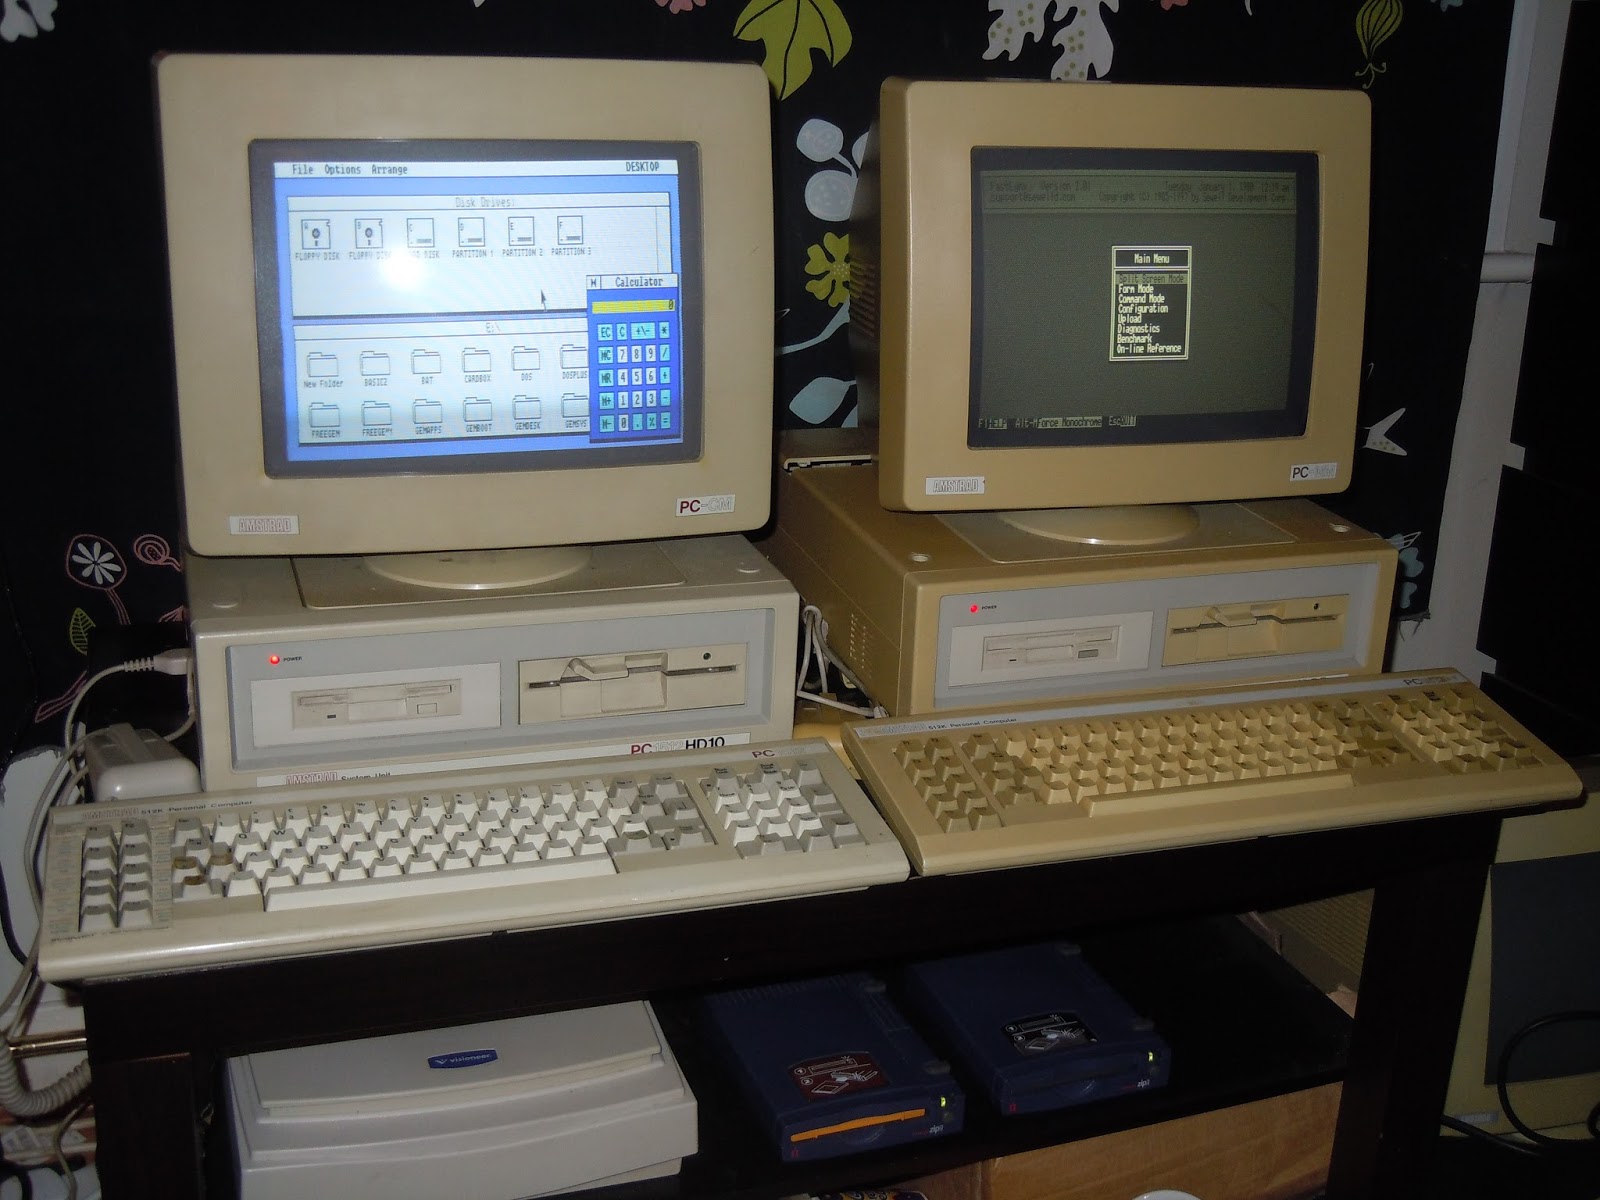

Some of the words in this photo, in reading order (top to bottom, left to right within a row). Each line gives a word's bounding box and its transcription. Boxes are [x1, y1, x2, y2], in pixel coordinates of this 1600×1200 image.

[292, 163, 314, 175] File
[324, 163, 361, 176] Options
[372, 163, 408, 177] Arrange
[625, 161, 660, 173] DESKTOP
[455, 197, 475, 208] Disk
[295, 251, 320, 261] FLOPPY
[323, 251, 341, 261] DISK
[349, 251, 373, 260] FLOPPY
[424, 250, 440, 259] DISK
[452, 249, 487, 258] PARTITION
[502, 248, 537, 257] PARTITION
[551, 247, 585, 257] PARTITION
[1134, 253, 1150, 264] Main
[1153, 253, 1170, 264] Menu
[615, 276, 664, 288] Calculator
[1120, 274, 1138, 284] Split
[1142, 274, 1166, 284] Screen
[1168, 273, 1184, 284] Mode
[1118, 284, 1135, 294] Form
[1138, 284, 1154, 294] Mode
[1118, 294, 1146, 304] Command
[1149, 294, 1165, 304] Mode
[667, 300, 674, 310] 0
[1118, 304, 1169, 314] Configuration
[1118, 313, 1142, 324] Upload
[601, 326, 611, 338] EC
[619, 326, 625, 338] C
[1117, 324, 1160, 334] Diagnostics
[1117, 334, 1152, 344] Benchmark
[1117, 344, 1144, 354] On-line
[1147, 343, 1182, 353] Reference
[601, 350, 612, 362] MC
[620, 349, 626, 360] 7
[634, 348, 639, 360] 8
[648, 348, 654, 359] 9
[464, 374, 492, 384] CARDBOX
[520, 371, 533, 381] DOS
[562, 370, 588, 381] DOSPLUS
[601, 372, 612, 384] MR
[620, 371, 626, 383] 4
[634, 371, 639, 382] 5
[649, 371, 655, 382] 6
[304, 380, 317, 389] New
[319, 379, 344, 389] Folder
[364, 378, 388, 387] BASIC2
[421, 376, 434, 386] BAT
[601, 395, 612, 407] M+
[620, 394, 626, 406] 1
[635, 393, 640, 405] 2
[649, 393, 654, 404] 3
[514, 421, 541, 431] GEMDESK
[564, 419, 588, 429] GEMSYS
[621, 417, 627, 429] 0
[1061, 416, 1102, 428] Monochrome
[415, 425, 442, 436] GEMAPPS
[465, 423, 493, 433] GEMBOOT
[311, 429, 340, 439] FREEGEM
[933, 479, 979, 493] AMSTRAD
[679, 496, 732, 514] PC-CM
[238, 517, 292, 533] AMSTRAD
[950, 721, 980, 729] Personal
[983, 717, 1018, 726] Computer
[684, 736, 727, 751] HD10
[751, 749, 776, 759] PC
[285, 771, 339, 786] AMSTRAD
[169, 803, 207, 813] Personal
[211, 800, 254, 809] Computer
[238, 832, 248, 840] Q
[273, 829, 287, 837] W
[449, 1053, 491, 1063] visioneer
